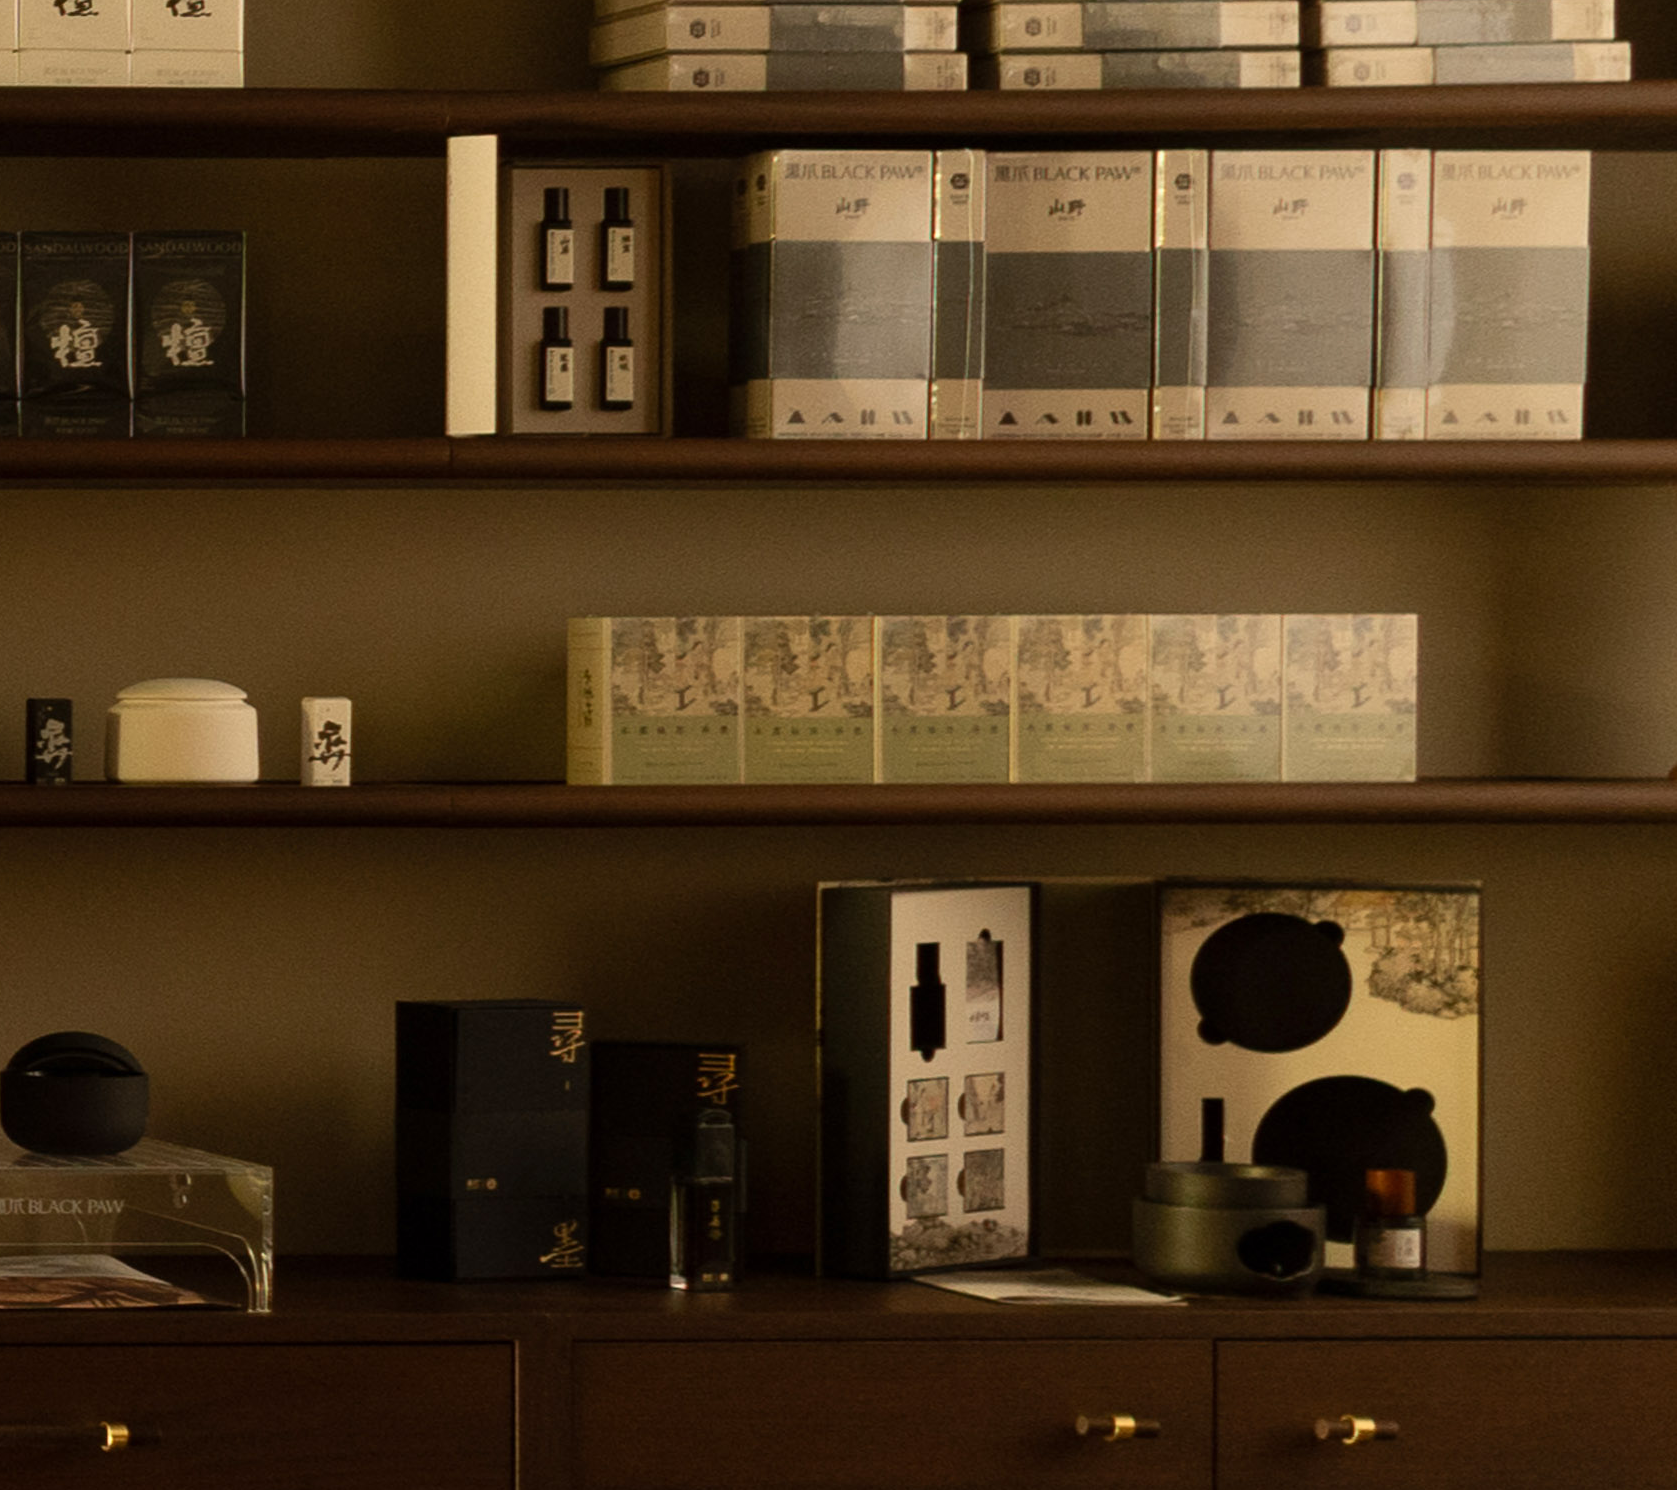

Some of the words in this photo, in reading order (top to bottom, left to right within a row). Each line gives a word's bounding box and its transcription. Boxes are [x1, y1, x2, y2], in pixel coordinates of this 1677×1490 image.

[821, 164, 875, 180] BLACK
[1033, 166, 1090, 181] BLACK
[1258, 164, 1316, 180] BLACK
[28, 1198, 84, 1215] BLACK
[87, 1198, 126, 1215] PAW
